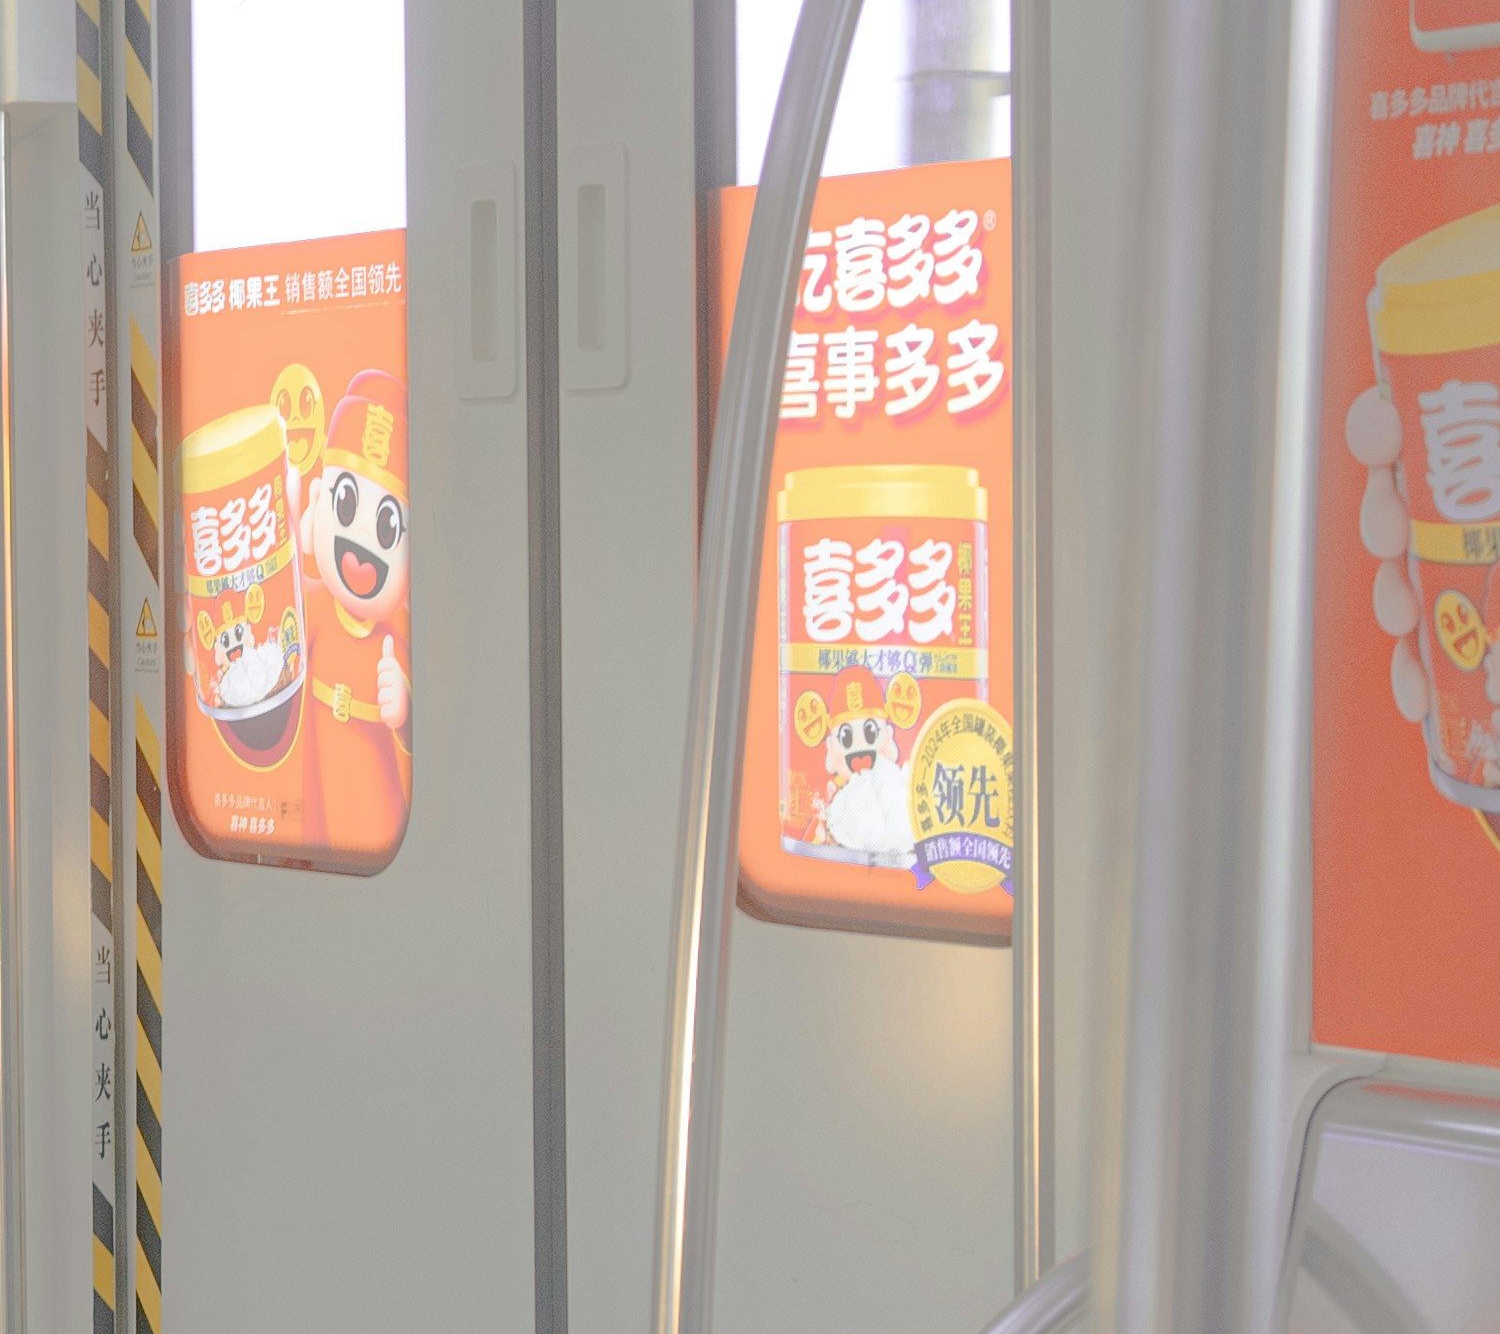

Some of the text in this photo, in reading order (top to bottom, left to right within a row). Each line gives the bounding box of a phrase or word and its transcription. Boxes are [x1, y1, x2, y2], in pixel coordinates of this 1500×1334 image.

[1412, 123, 1459, 161] 喜神
[84, 190, 105, 408] 当心夹手
[184, 261, 403, 317] 喜多多 椰果王 销售额全国领先
[190, 482, 278, 577] 喜多多
[802, 538, 957, 644] 喜多多
[957, 541, 973, 647] 椰果王
[930, 762, 1001, 829] 领先
[924, 835, 1013, 871] 销售额全国领先
[95, 945, 112, 1161] 当心夹手
